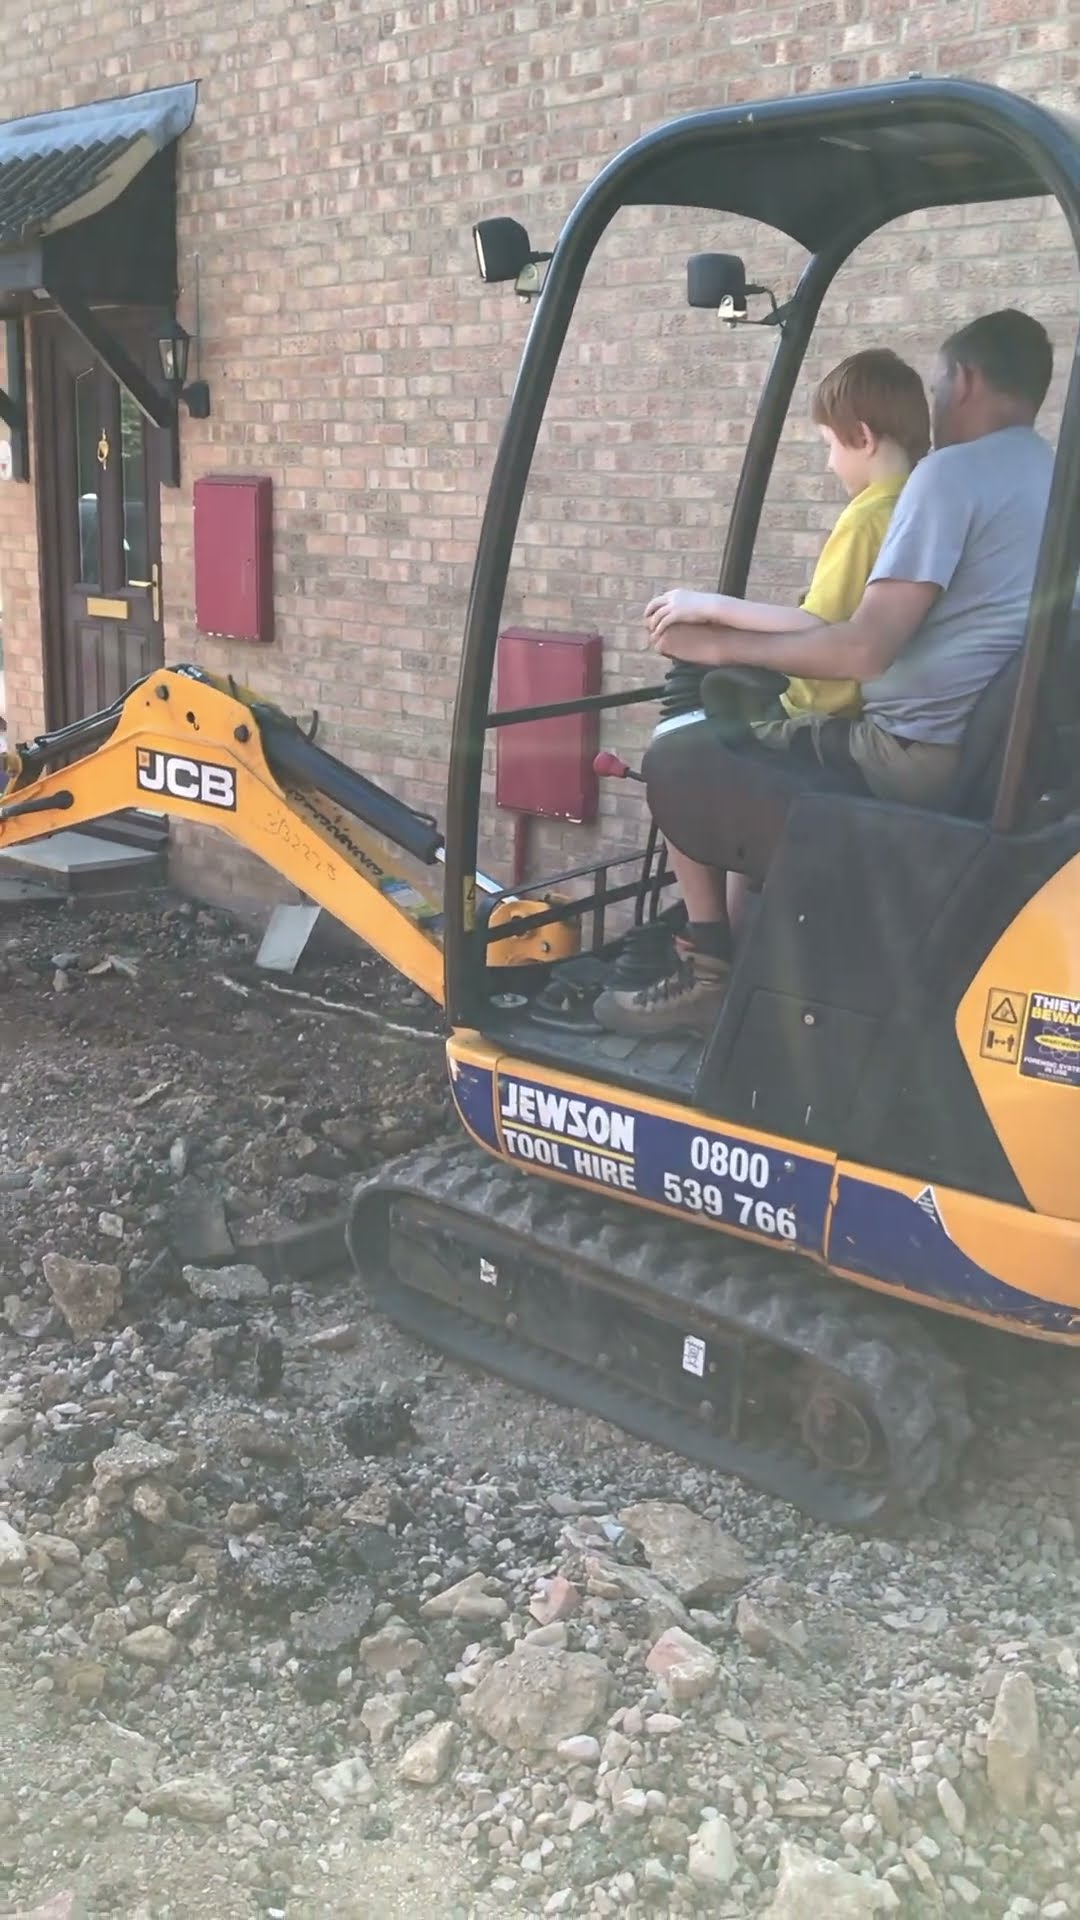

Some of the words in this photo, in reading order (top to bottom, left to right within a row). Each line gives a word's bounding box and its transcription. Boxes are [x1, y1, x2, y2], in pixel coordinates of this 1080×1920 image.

[139, 753, 235, 807] JCB
[501, 1083, 635, 1152] JEWSON
[502, 1128, 568, 1169] TOOL
[574, 1149, 637, 1190] HIRE
[690, 1136, 769, 1189] 0800
[663, 1172, 723, 1216] 539
[734, 1193, 798, 1239] 766
